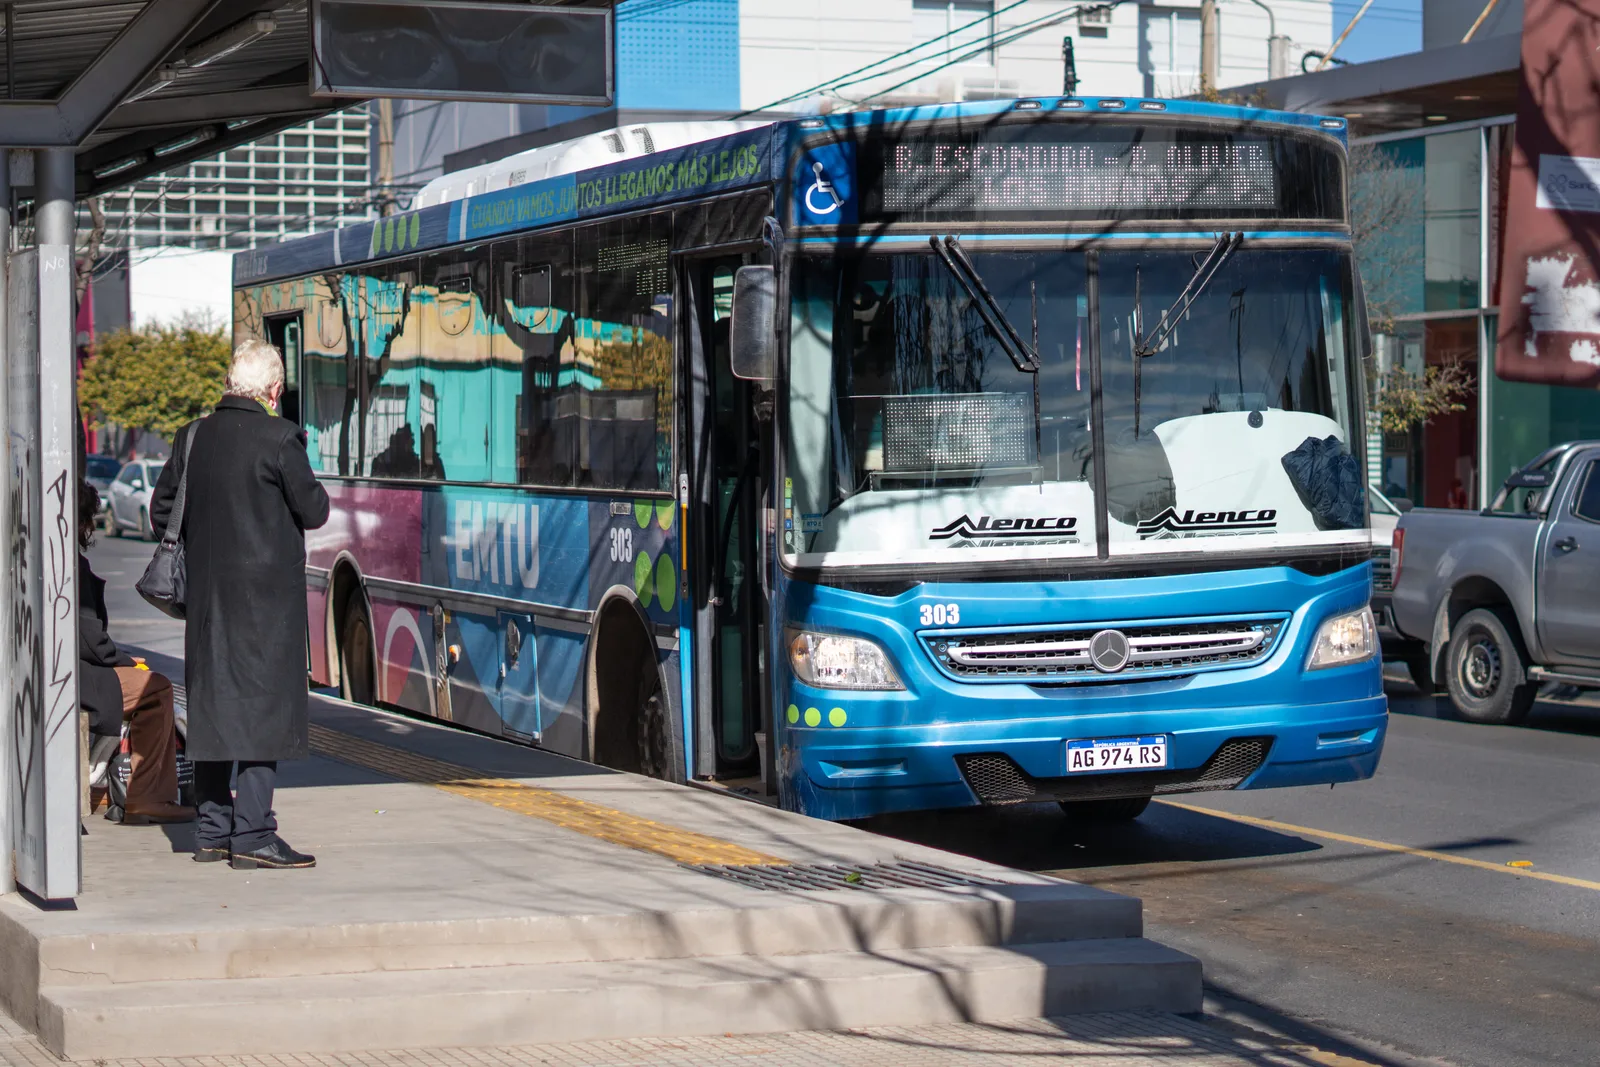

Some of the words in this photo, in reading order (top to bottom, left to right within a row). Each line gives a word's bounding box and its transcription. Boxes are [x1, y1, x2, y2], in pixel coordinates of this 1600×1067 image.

[935, 146, 1094, 172] ESCONDIDO
[1168, 146, 1263, 172] OLIVER
[471, 199, 515, 229] CUANDO
[517, 191, 555, 221] VAMOS
[556, 180, 602, 214] JUNTOS
[605, 162, 675, 205] LLEGAMOS
[677, 150, 708, 191] MÁS
[711, 143, 762, 183] LEJOS.
[984, 176, 1047, 203] LOS
[932, 514, 1078, 538] Alenco
[1138, 507, 1277, 531] Alenco
[455, 499, 540, 589] EMTU
[610, 527, 633, 563] 303
[919, 603, 960, 626] 303
[1073, 750, 1094, 768] AG
[1101, 748, 1133, 766] 974
[1140, 746, 1161, 763] RS
